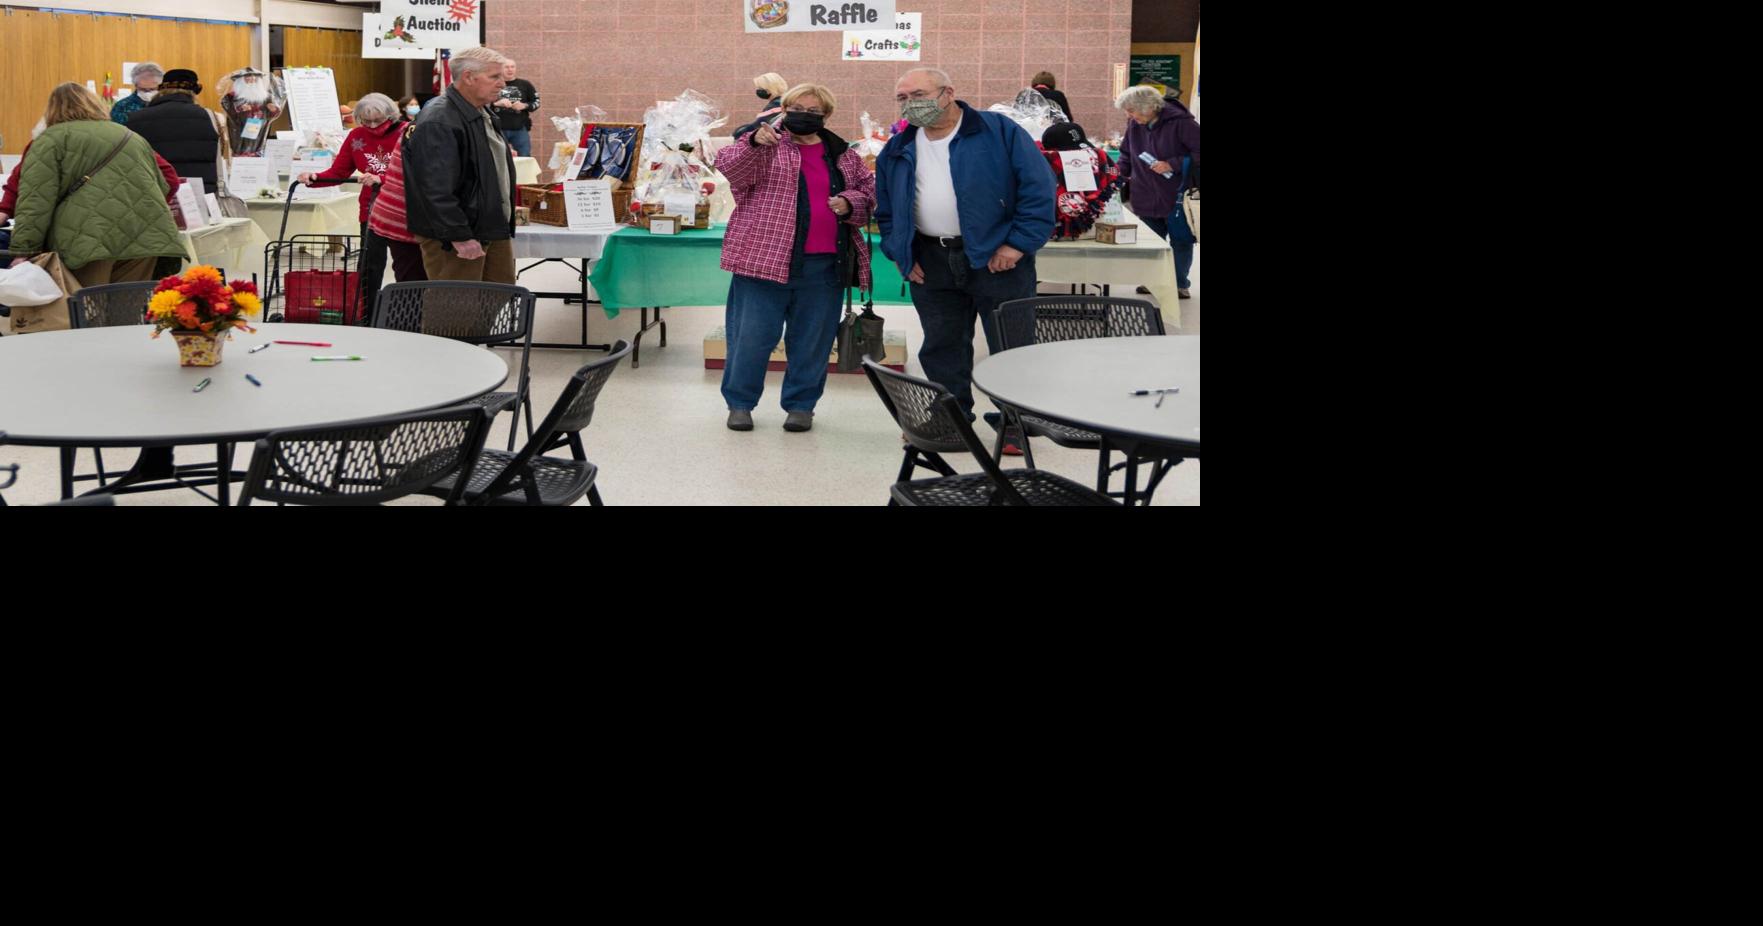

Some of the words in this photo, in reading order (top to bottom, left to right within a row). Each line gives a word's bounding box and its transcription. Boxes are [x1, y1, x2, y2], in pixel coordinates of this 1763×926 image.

[810, 3, 878, 26] Raffle
[407, 16, 461, 31] Auction
[864, 39, 899, 50] Crafts
